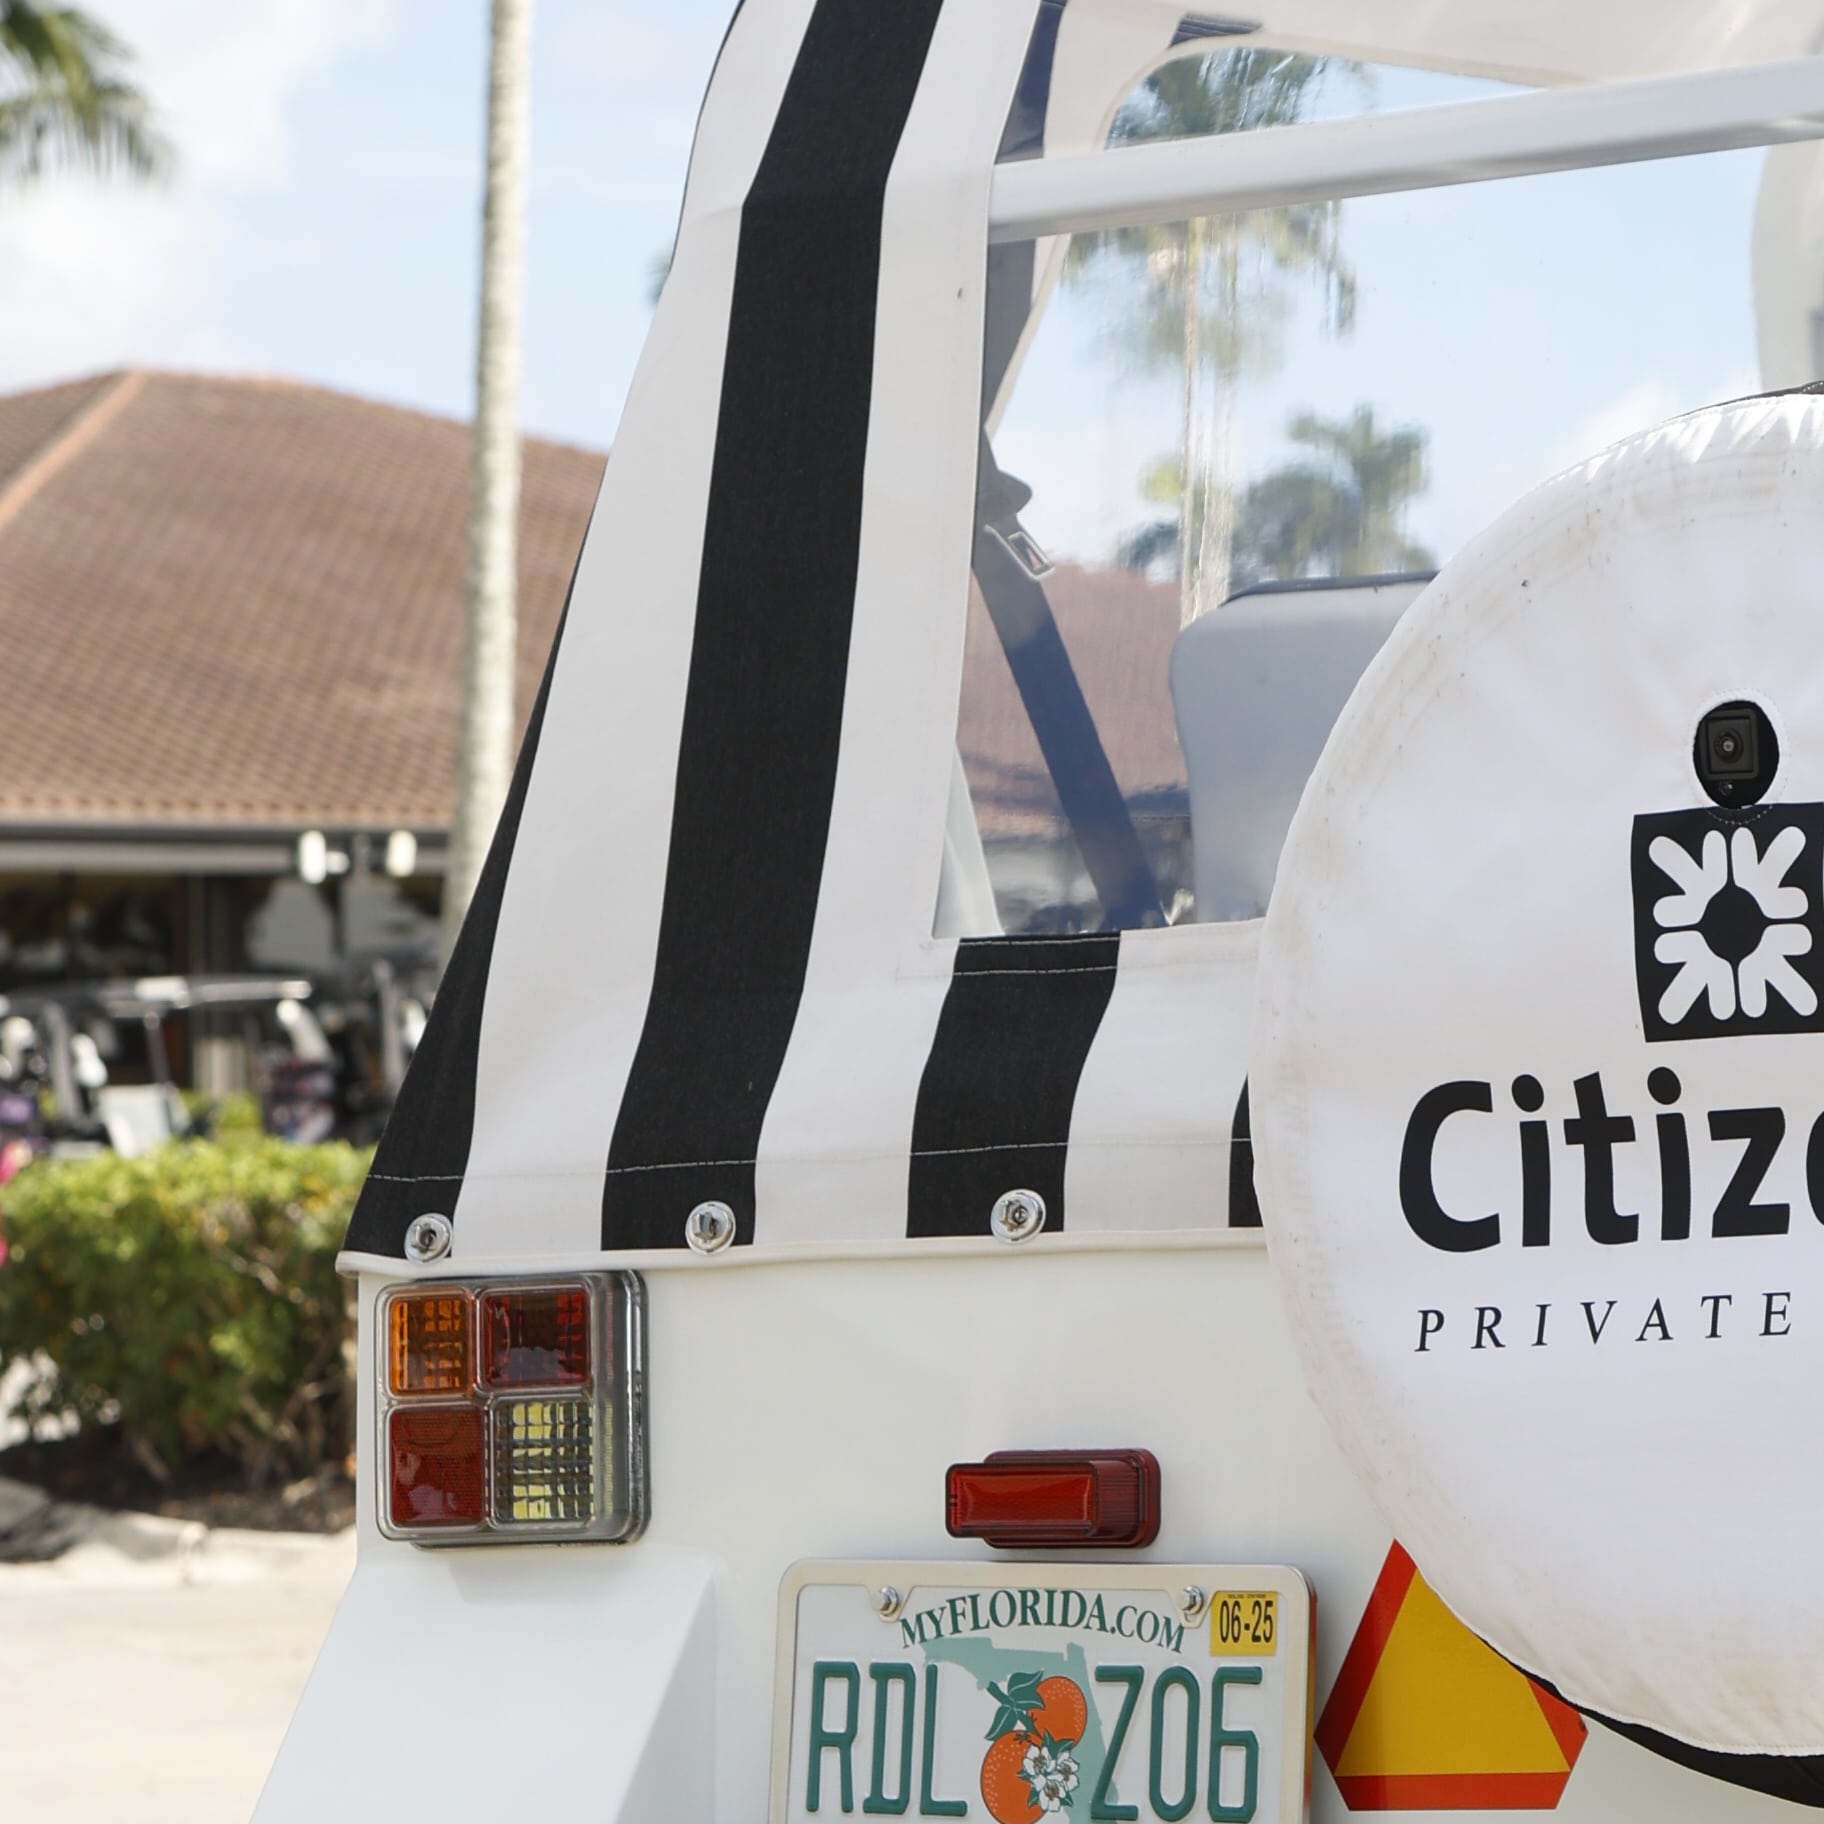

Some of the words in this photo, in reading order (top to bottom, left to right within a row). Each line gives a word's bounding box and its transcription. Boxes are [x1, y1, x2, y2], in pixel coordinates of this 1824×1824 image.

[1414, 1291, 1793, 1353] PRIVATE
[899, 1588, 1186, 1654] MYFLORIDA.COM
[806, 1660, 969, 1818] RDL
[1089, 1664, 1264, 1824] Z06
